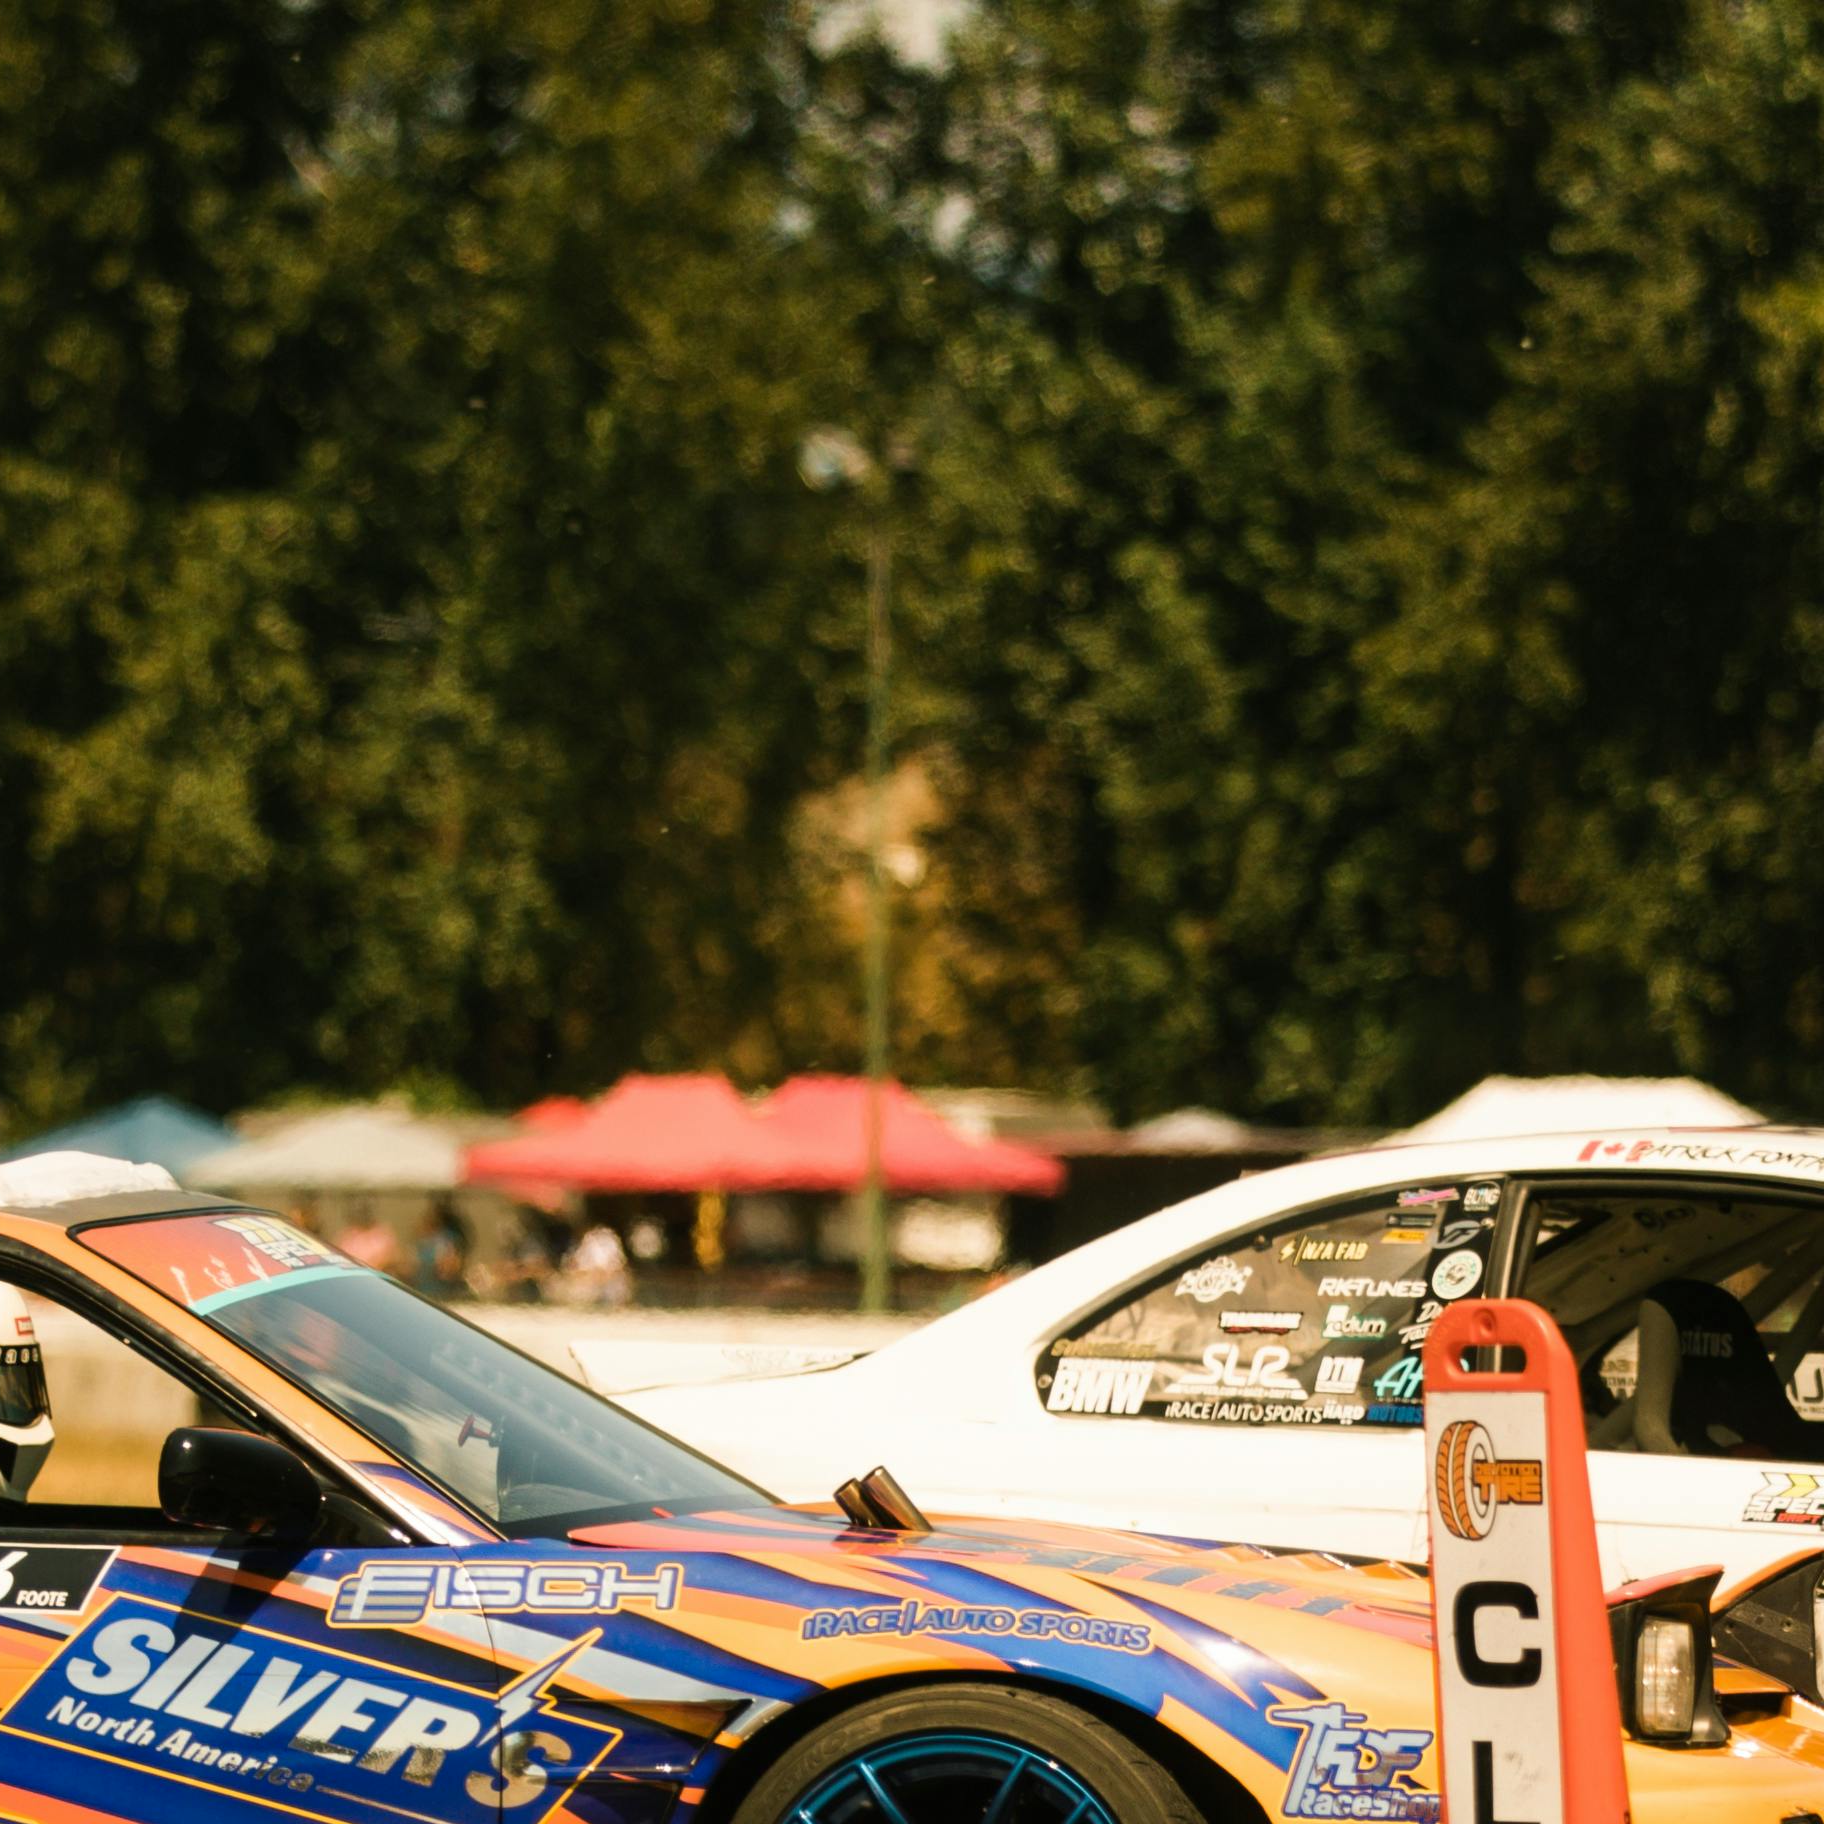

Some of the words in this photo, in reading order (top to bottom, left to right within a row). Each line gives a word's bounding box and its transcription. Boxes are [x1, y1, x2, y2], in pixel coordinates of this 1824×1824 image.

[1046, 1369, 1155, 1415] BMW
[1263, 1404, 1323, 1424] SPORTS
[1473, 1475, 1542, 1503] TIRE
[1776, 1512, 1822, 1525] DRIFT
[16, 1590, 69, 1608] FOOTE
[1018, 1612, 1152, 1651] SPORTS
[64, 1615, 574, 1810] SILVER'S
[46, 1694, 157, 1750] North
[156, 1728, 314, 1795] America
